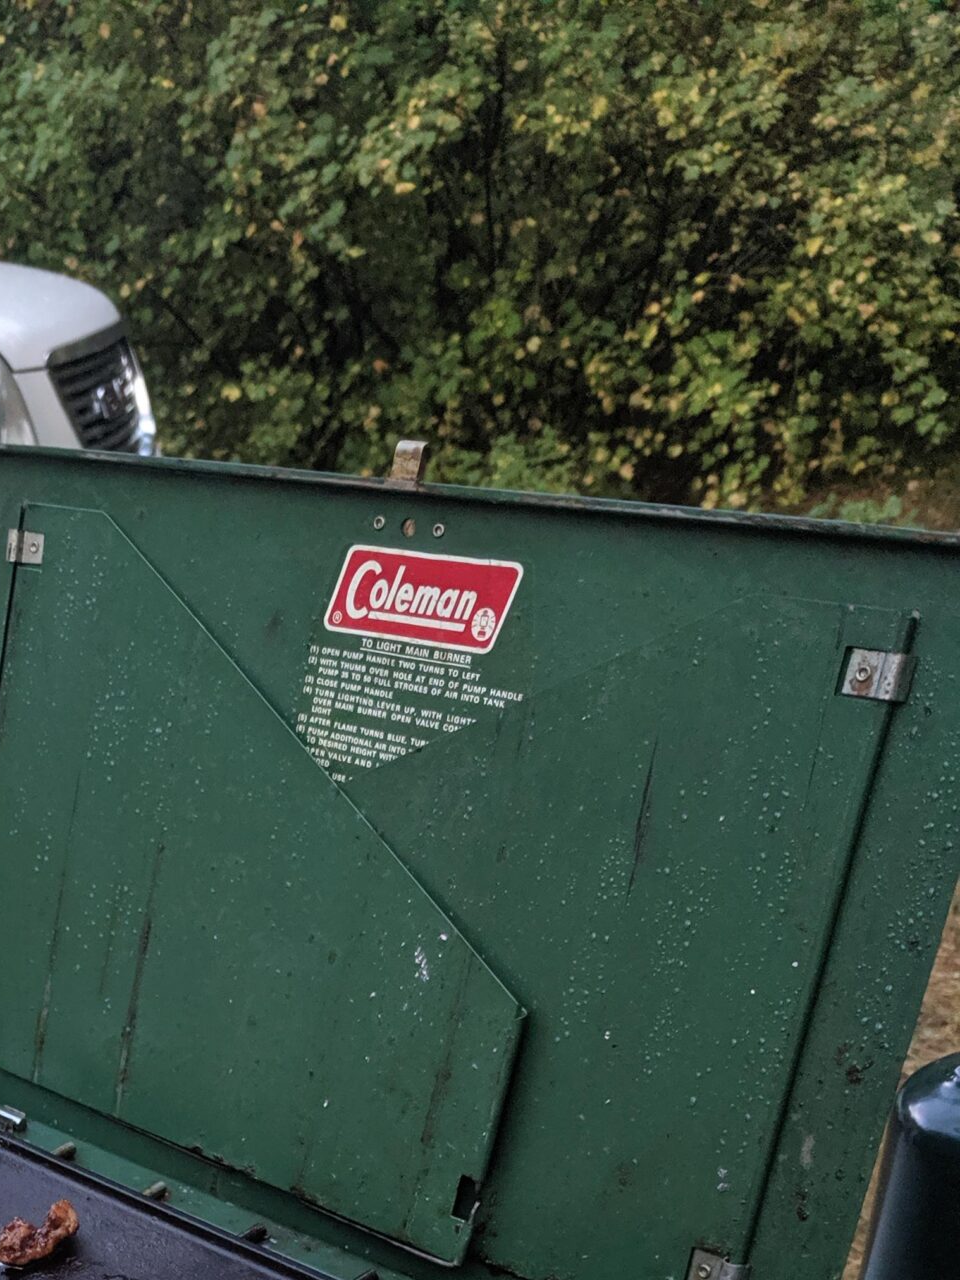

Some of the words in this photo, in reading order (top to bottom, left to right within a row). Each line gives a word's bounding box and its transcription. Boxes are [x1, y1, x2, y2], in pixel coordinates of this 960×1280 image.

[345, 559, 478, 621] Coleman
[322, 647, 340, 657] OPEN
[342, 650, 363, 660] PUMP
[366, 654, 395, 667] HANDLE
[398, 660, 415, 670] TWO
[419, 664, 445, 675] TURNS
[448, 668, 459, 677] TO
[462, 671, 480, 681] LEFT
[362, 638, 373, 648] TO
[376, 641, 402, 653] LIGHT
[405, 646, 429, 658] MAIN
[433, 651, 472, 664] BURNER
[317, 677, 338, 688] CLOSE
[340, 681, 362, 692] PUMP
[364, 686, 394, 699] HANDLE
[318, 667, 339, 677] PUMP
[352, 671, 361, 680] TO
[374, 675, 391, 687] FULL
[394, 680, 428, 694] STROKES
[431, 686, 441, 696] OF
[444, 688, 458, 699] AIR
[461, 691, 480, 703] INTO
[320, 658, 337, 668] WITH
[340, 661, 366, 673] THUMB
[369, 666, 389, 677] OVER
[393, 670, 412, 681] HOLE
[415, 676, 425, 684] AT
[429, 676, 445, 687] END
[448, 679, 459, 688] OF
[462, 683, 486, 695] PUMP
[490, 687, 524, 702] HANDLE
[311, 706, 332, 716] LIGHT
[313, 697, 332, 708] OVER
[334, 701, 354, 712] MAIN
[357, 704, 387, 719] BURNER
[391, 712, 411, 723] OPEN
[415, 718, 439, 730] VALVE
[315, 688, 334, 699] TURN
[337, 692, 374, 707] LIGHTING
[376, 699, 401, 712] LEVER
[421, 710, 442, 721] WITH
[307, 726, 329, 737] PUMP
[330, 731, 372, 748] ADDITIONAL
[374, 740, 387, 751] AIR
[388, 743, 406, 755] INTO
[309, 715, 331, 727] AFTER
[334, 721, 357, 733] FLAME
[360, 725, 384, 739] TURNS
[306, 735, 316, 744] TO
[318, 738, 347, 752] DESIRED
[350, 745, 378, 758] HEIGHT
[328, 752, 352, 764] VALVE
[354, 758, 372, 769] AND
[332, 772, 346, 783] USE
